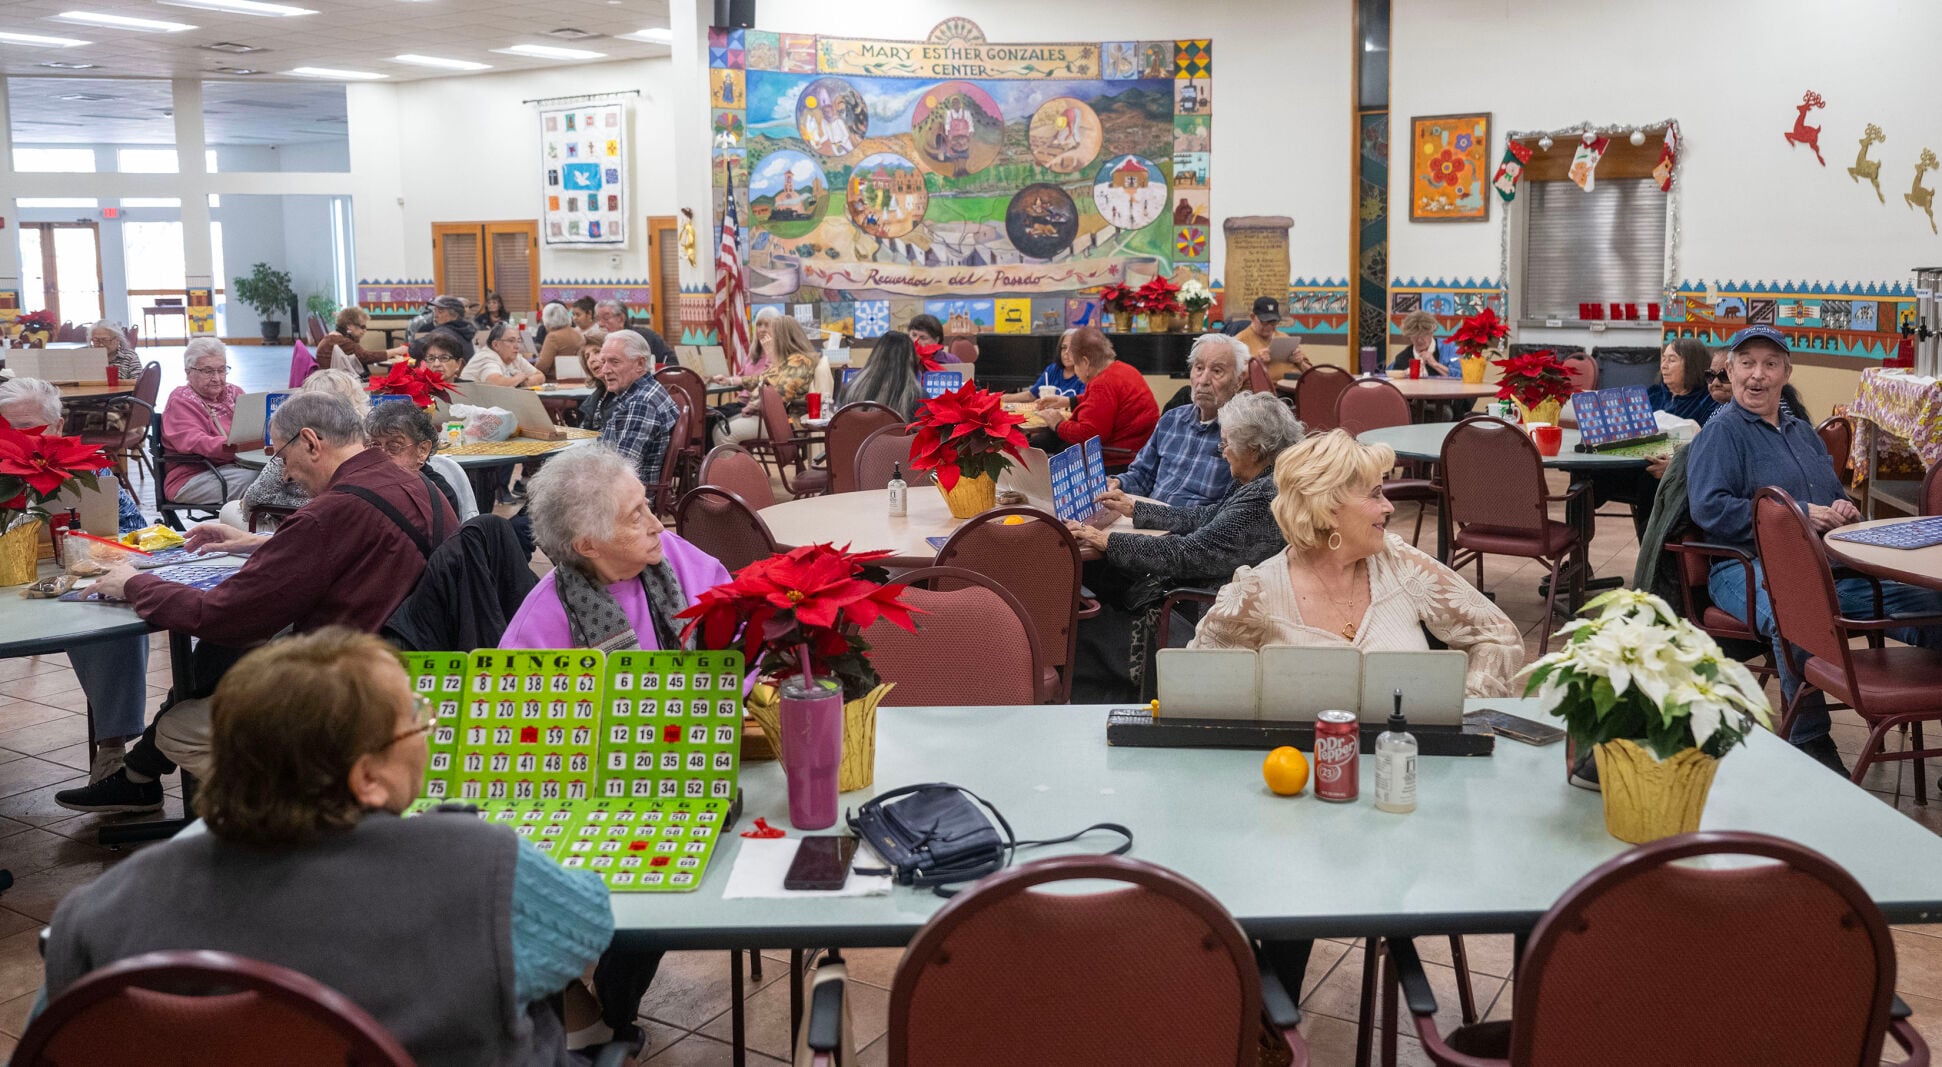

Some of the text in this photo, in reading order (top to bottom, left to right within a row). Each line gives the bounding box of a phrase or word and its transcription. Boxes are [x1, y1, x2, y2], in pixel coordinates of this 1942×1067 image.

[862, 45, 1066, 62] MARY ESTHER GONZALES
[932, 64, 991, 77] CENTER
[948, 273, 983, 286] del
[992, 270, 1047, 289] Pasado
[420, 679, 459, 689] 51 72
[480, 677, 594, 691] 8 24 38 46 62
[621, 677, 735, 688] 6 28 45 57 74
[442, 705, 456, 715] 73
[477, 704, 592, 717] 5 20 39 51 70
[616, 704, 733, 714] 13 22 43 59 63
[438, 731, 452, 741] 70
[474, 730, 589, 744] 3 22 59 67
[614, 730, 732, 740] 12 19 47 70
[1327, 737, 1345, 750] Dr
[1317, 738, 1355, 763] Pepper
[433, 757, 447, 767] 61
[468, 757, 587, 771] 12 27 41 48 68
[614, 756, 730, 767] 5 20 35 48 64
[430, 783, 444, 793] 75
[466, 784, 584, 798] 11 23 36 56 71
[609, 783, 727, 794] 11 21 34 52 61
